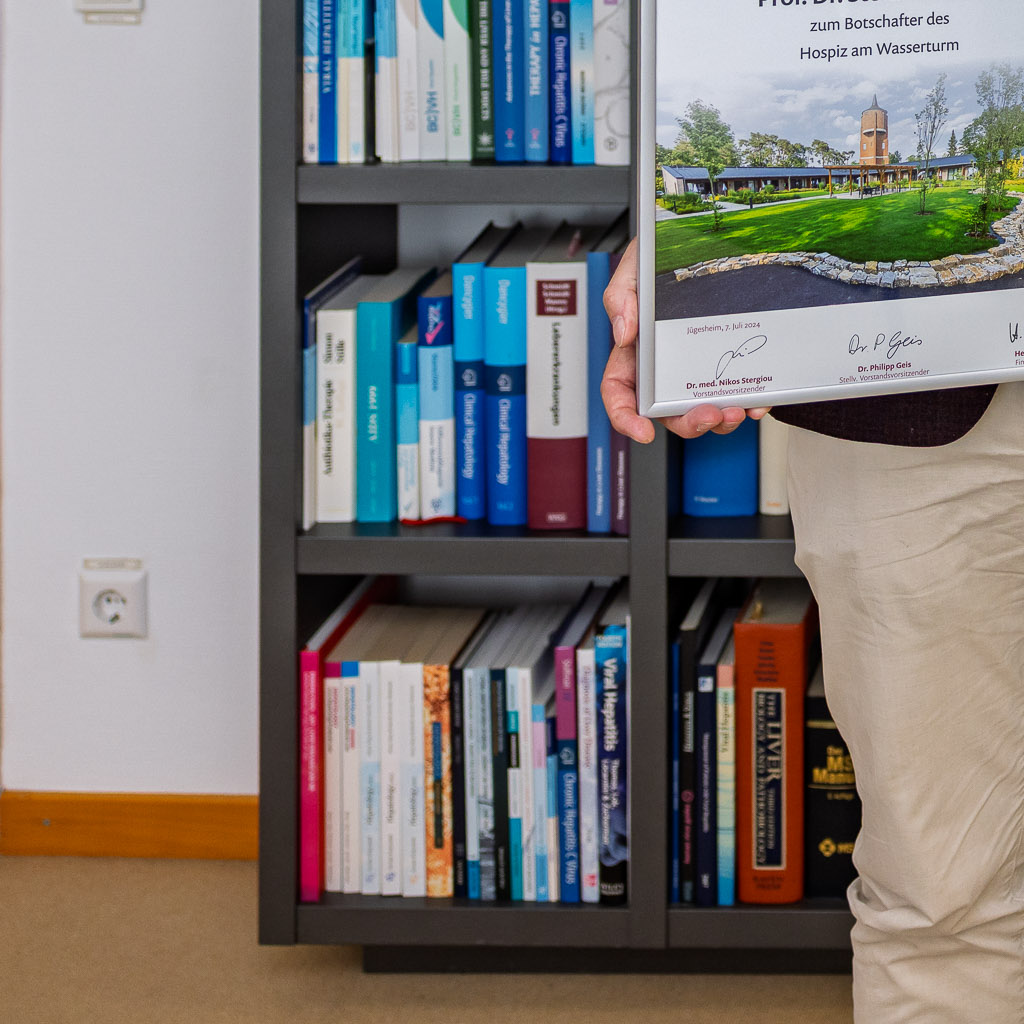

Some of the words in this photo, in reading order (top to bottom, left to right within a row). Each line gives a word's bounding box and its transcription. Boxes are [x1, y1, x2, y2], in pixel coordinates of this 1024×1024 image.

[529, 31, 541, 43] in
[809, 20, 841, 33] zum
[844, 14, 923, 31] Botschafter
[926, 12, 950, 27] des
[554, 36, 568, 72] Chronic
[800, 44, 848, 63] Hospiz
[851, 46, 873, 57] am
[876, 39, 959, 56] Wasserturm
[322, 59, 332, 94] VIRAL
[528, 45, 541, 97] THERAPY
[553, 72, 568, 115] Hepatitis
[555, 122, 568, 148] Virus
[687, 323, 723, 335] Jügesheim,
[724, 323, 731, 332] 7.
[732, 321, 745, 332] Juli
[745, 321, 761, 331] 2024
[886, 330, 923, 359] Geis
[323, 332, 333, 365] Simon
[335, 340, 345, 365] Stille
[550, 322, 562, 426] Lebererkrankungen
[686, 381, 698, 389] Dr.
[699, 380, 718, 388] med.
[719, 378, 740, 386] Nikos
[741, 375, 773, 386] Stergiou
[839, 376, 858, 384] Stellv.
[859, 369, 930, 382] Vorstandsvorsitzender
[870, 363, 894, 373] Philipp
[896, 361, 912, 369] Geis
[693, 385, 766, 398] Vorstandsvorsitzender
[463, 393, 476, 425] Clinical
[498, 398, 511, 431] Clinical
[462, 427, 476, 480] Hepatology
[496, 433, 511, 486] Hepatology
[603, 657, 618, 691] Viral
[601, 691, 618, 752] Hepatitis
[757, 693, 767, 742] BIOLOGY
[767, 694, 776, 717] THE
[758, 747, 767, 775] AND
[766, 721, 782, 781] LIVER
[563, 772, 576, 808] Chronic
[562, 809, 576, 852] Hepatitis
[758, 777, 768, 864] PATHOBIOLOGY
[564, 860, 577, 885] Virus
